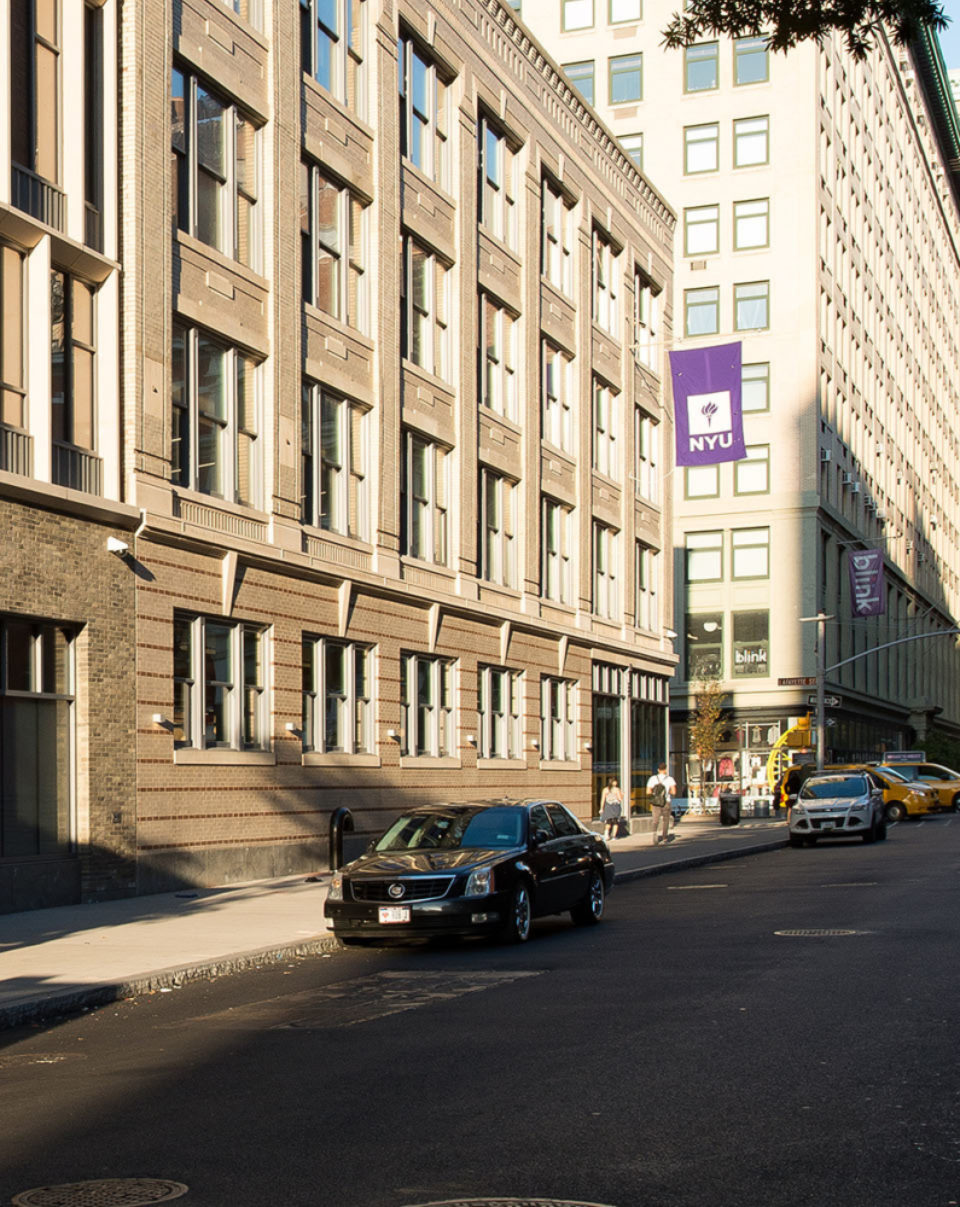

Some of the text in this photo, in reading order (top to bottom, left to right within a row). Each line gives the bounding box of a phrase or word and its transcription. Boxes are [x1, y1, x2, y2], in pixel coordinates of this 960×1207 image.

[689, 432, 732, 452] NYU
[853, 554, 879, 612] blink
[735, 648, 768, 663] blink
